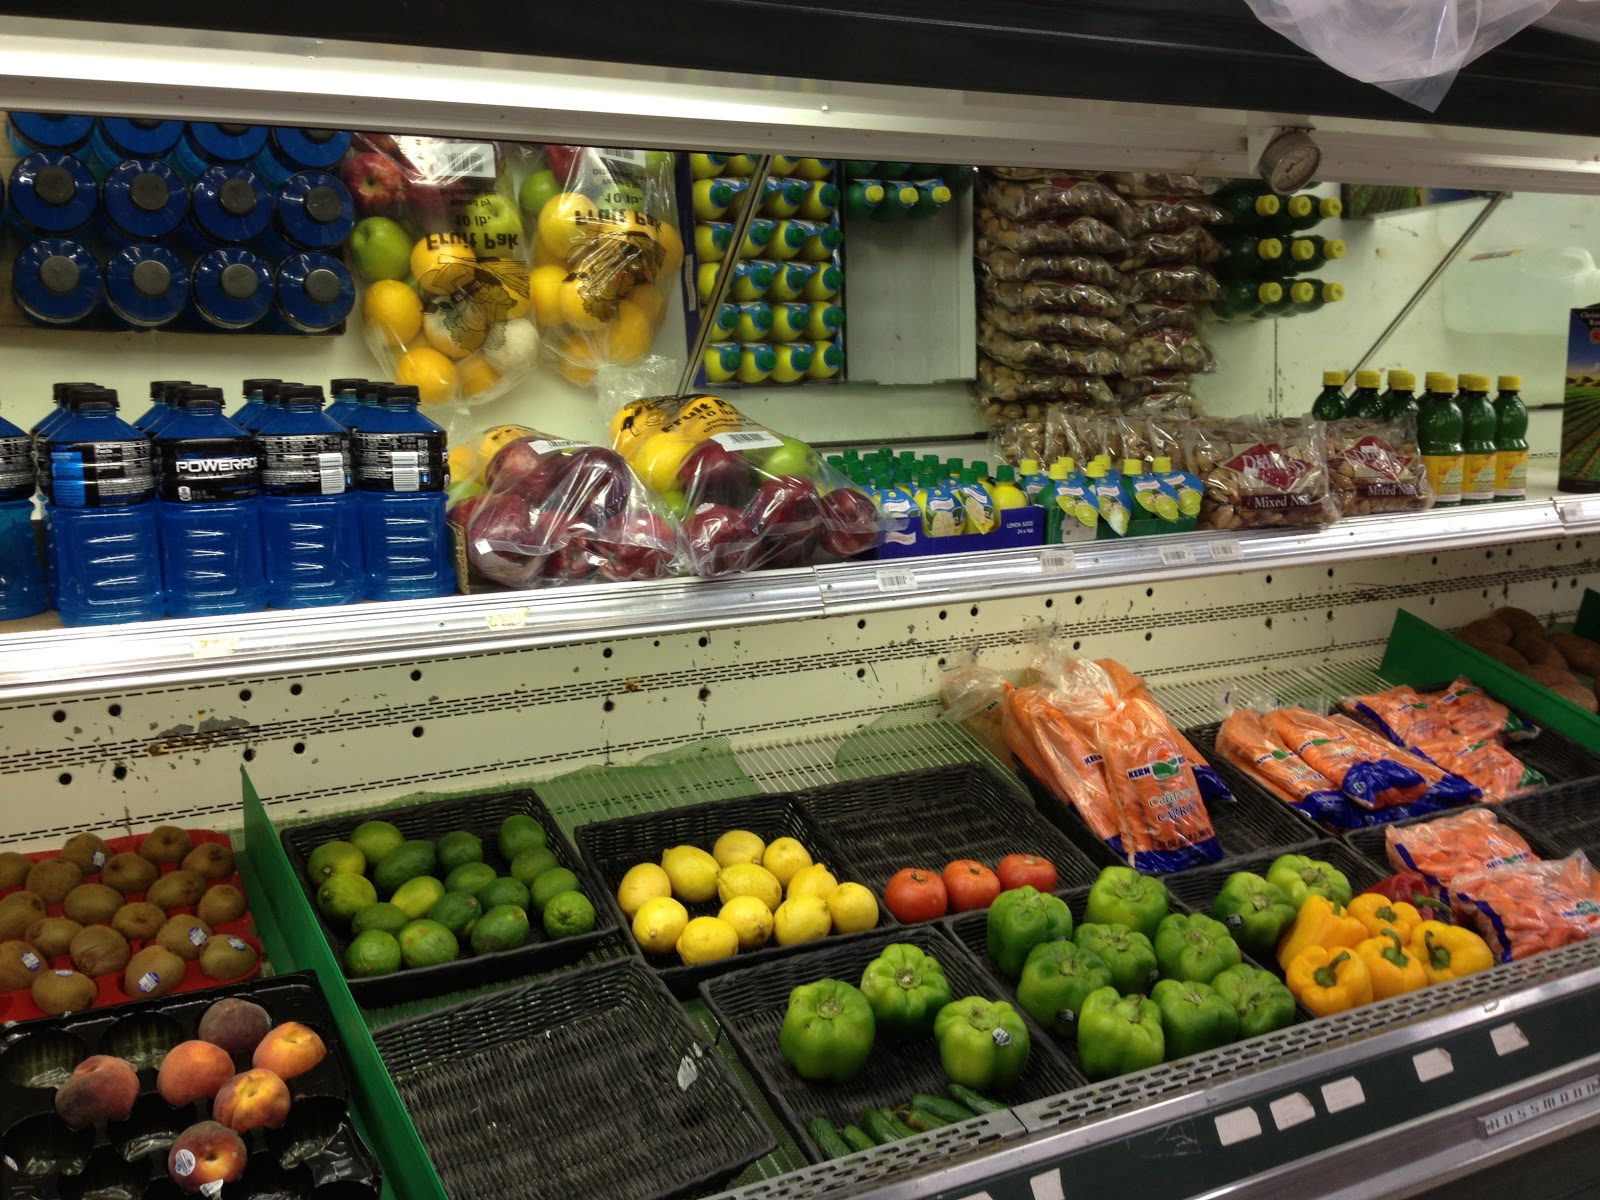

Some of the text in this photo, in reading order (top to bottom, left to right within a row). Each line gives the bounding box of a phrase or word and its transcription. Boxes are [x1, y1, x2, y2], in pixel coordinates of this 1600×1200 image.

[661, 402, 712, 433] Fruit
[1368, 484, 1397, 497] Mixed
[1254, 496, 1288, 509] Mixed
[1083, 754, 1104, 765] KERN
[1127, 766, 1151, 779] KERN
